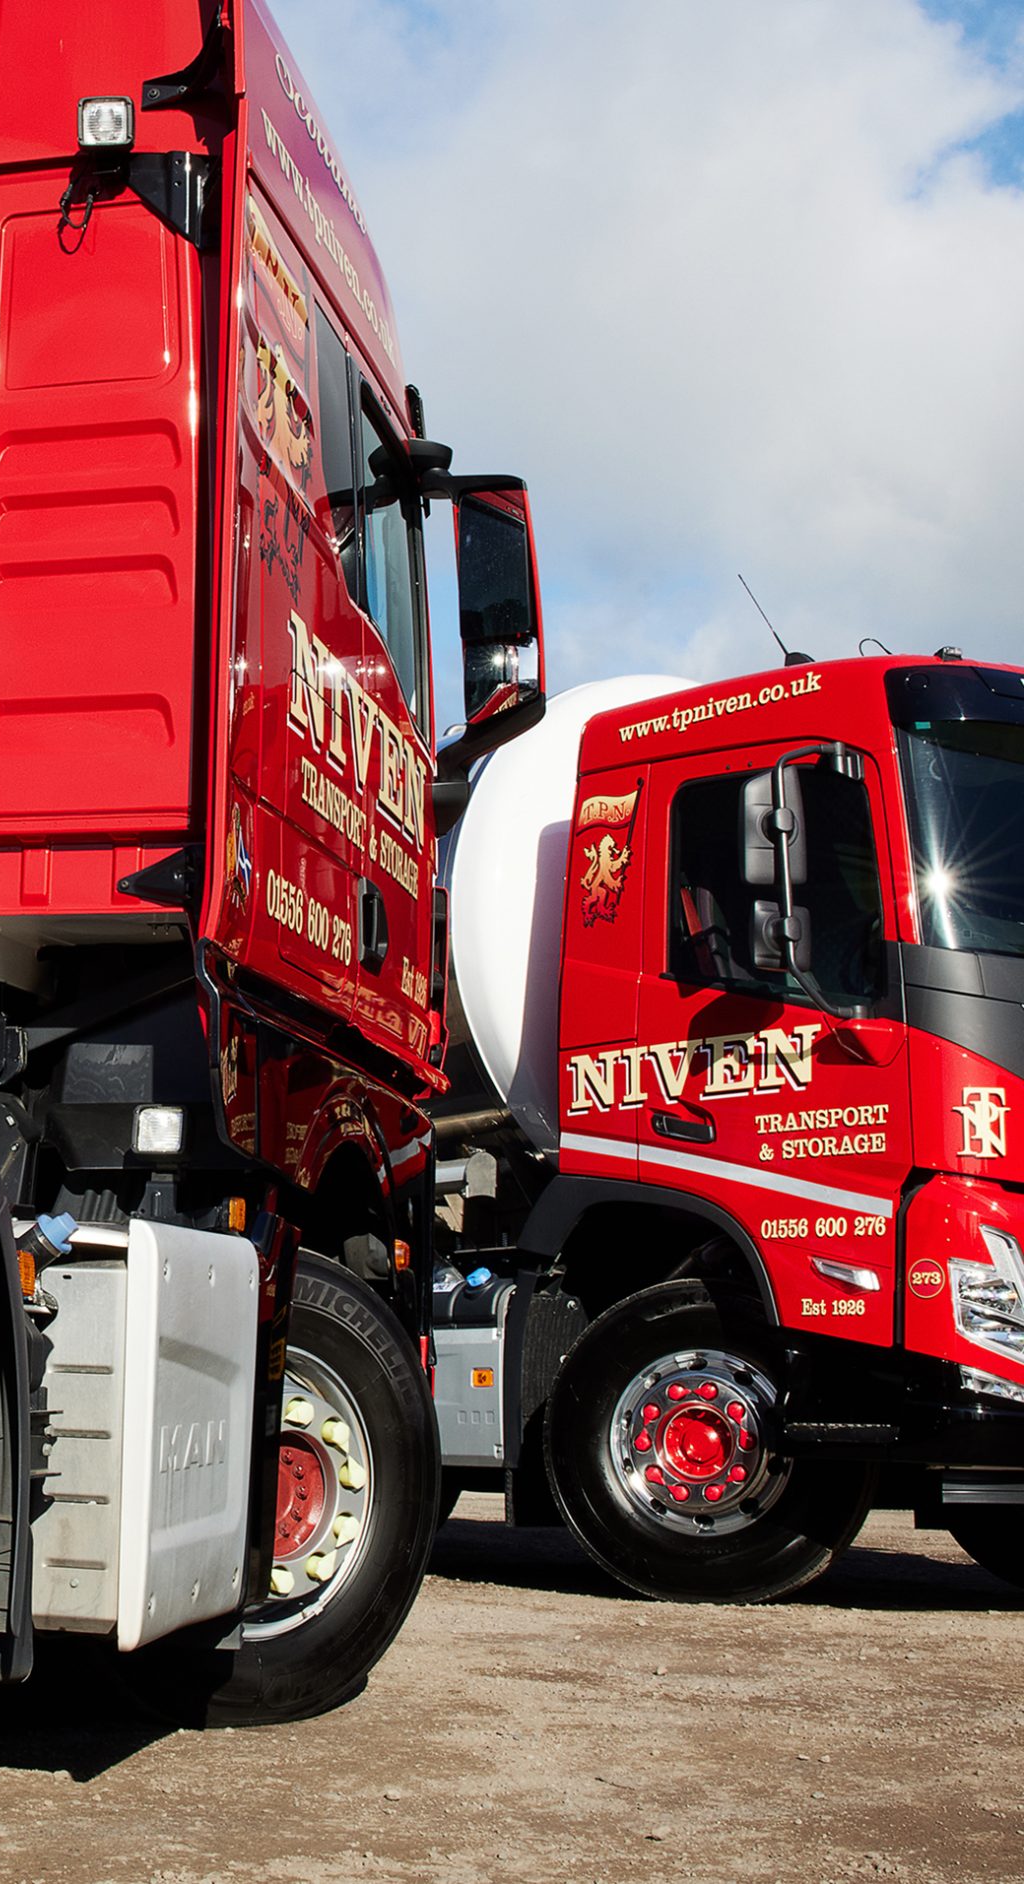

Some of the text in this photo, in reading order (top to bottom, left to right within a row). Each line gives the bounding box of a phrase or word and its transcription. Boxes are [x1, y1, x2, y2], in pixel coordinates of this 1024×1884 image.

[287, 608, 427, 854] NIVEN
[619, 671, 823, 743] www.tpniven.co.uk
[302, 756, 367, 852] TRANSPORT
[369, 824, 419, 900] & STORAGE
[266, 868, 352, 967] 01556 600 276
[567, 1024, 822, 1117] NIVEN
[755, 1104, 889, 1134] TRANSPORT
[759, 1133, 886, 1161] & STORAGE
[761, 1216, 886, 1238] 01556 600 276
[801, 1298, 865, 1316] Est 1926
[912, 1271, 941, 1286] 273
[160, 1419, 225, 1473] MAN
